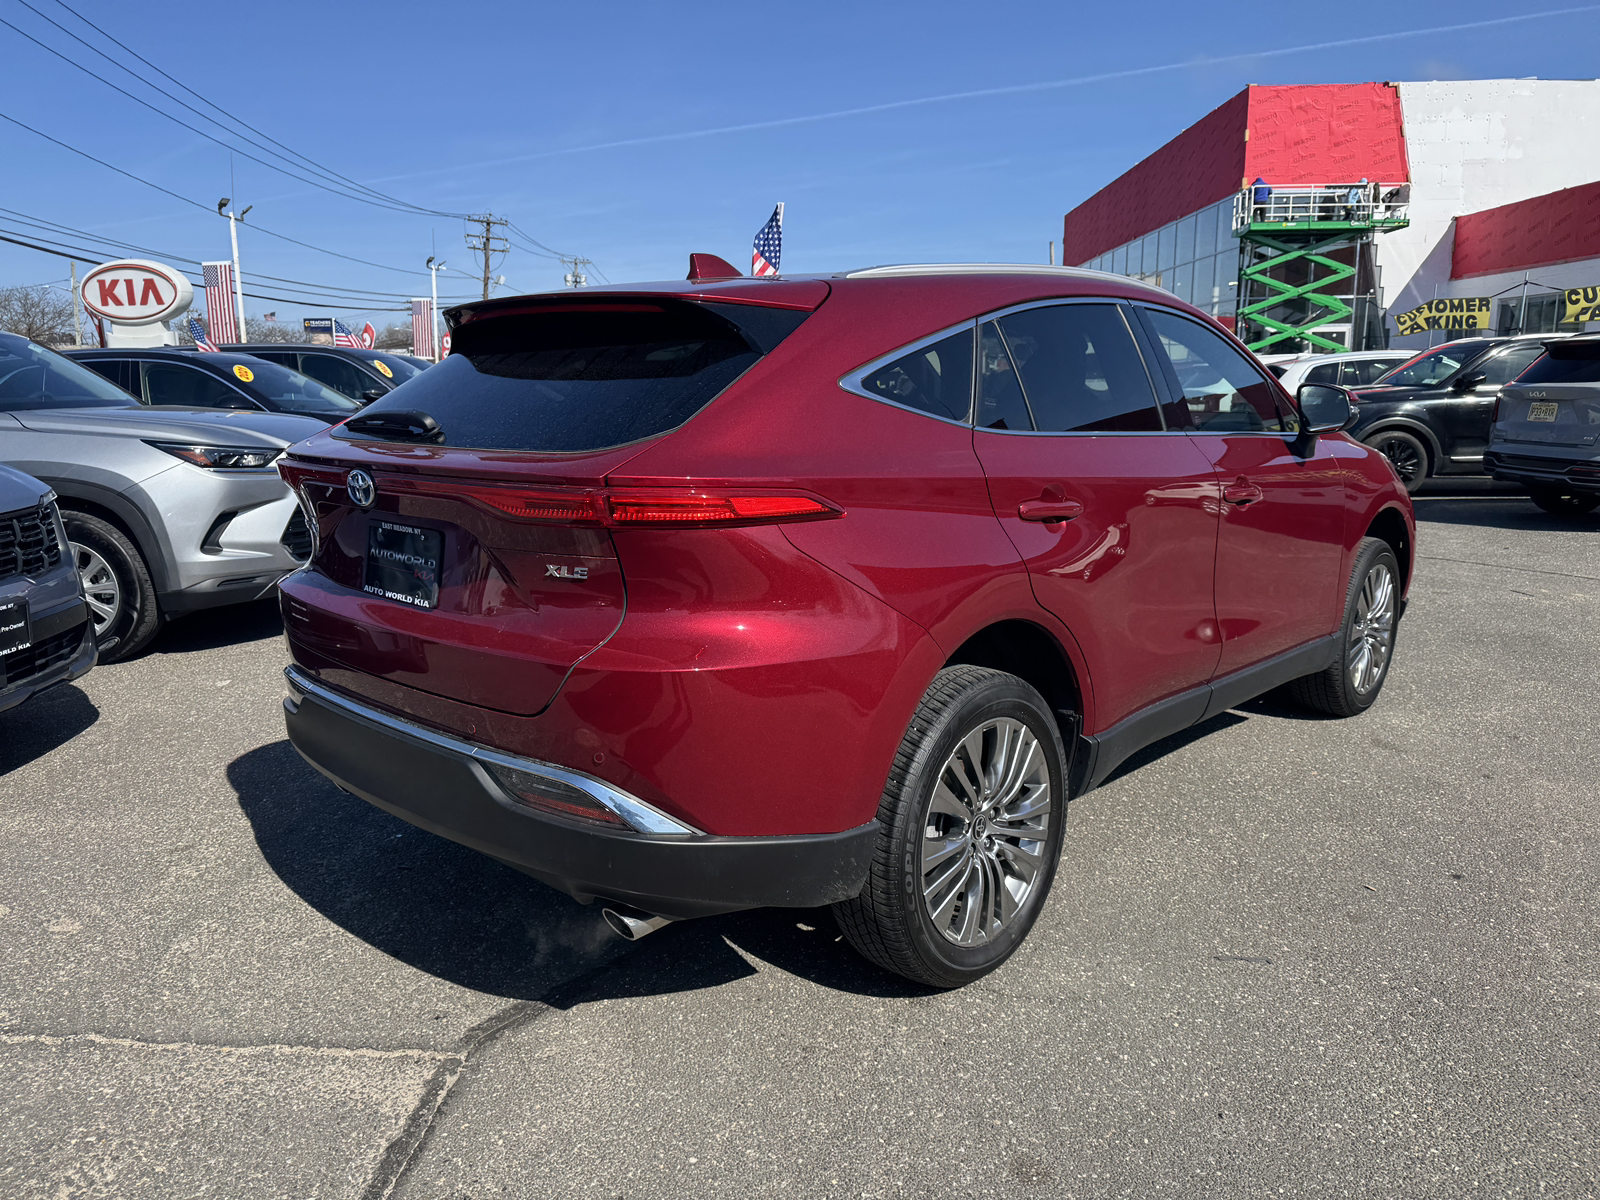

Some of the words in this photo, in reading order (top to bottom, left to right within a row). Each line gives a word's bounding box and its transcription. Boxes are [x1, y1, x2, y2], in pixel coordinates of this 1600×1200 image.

[97, 278, 165, 306] KIA
[382, 522, 393, 530] EAST
[370, 547, 436, 569] AUTOWORLD
[414, 569, 434, 581] KIA
[544, 564, 589, 580] XLE
[364, 584, 384, 596] AUTO
[385, 590, 413, 604] WORLD
[414, 597, 430, 608] KIA
[18, 642, 31, 651] KIA
